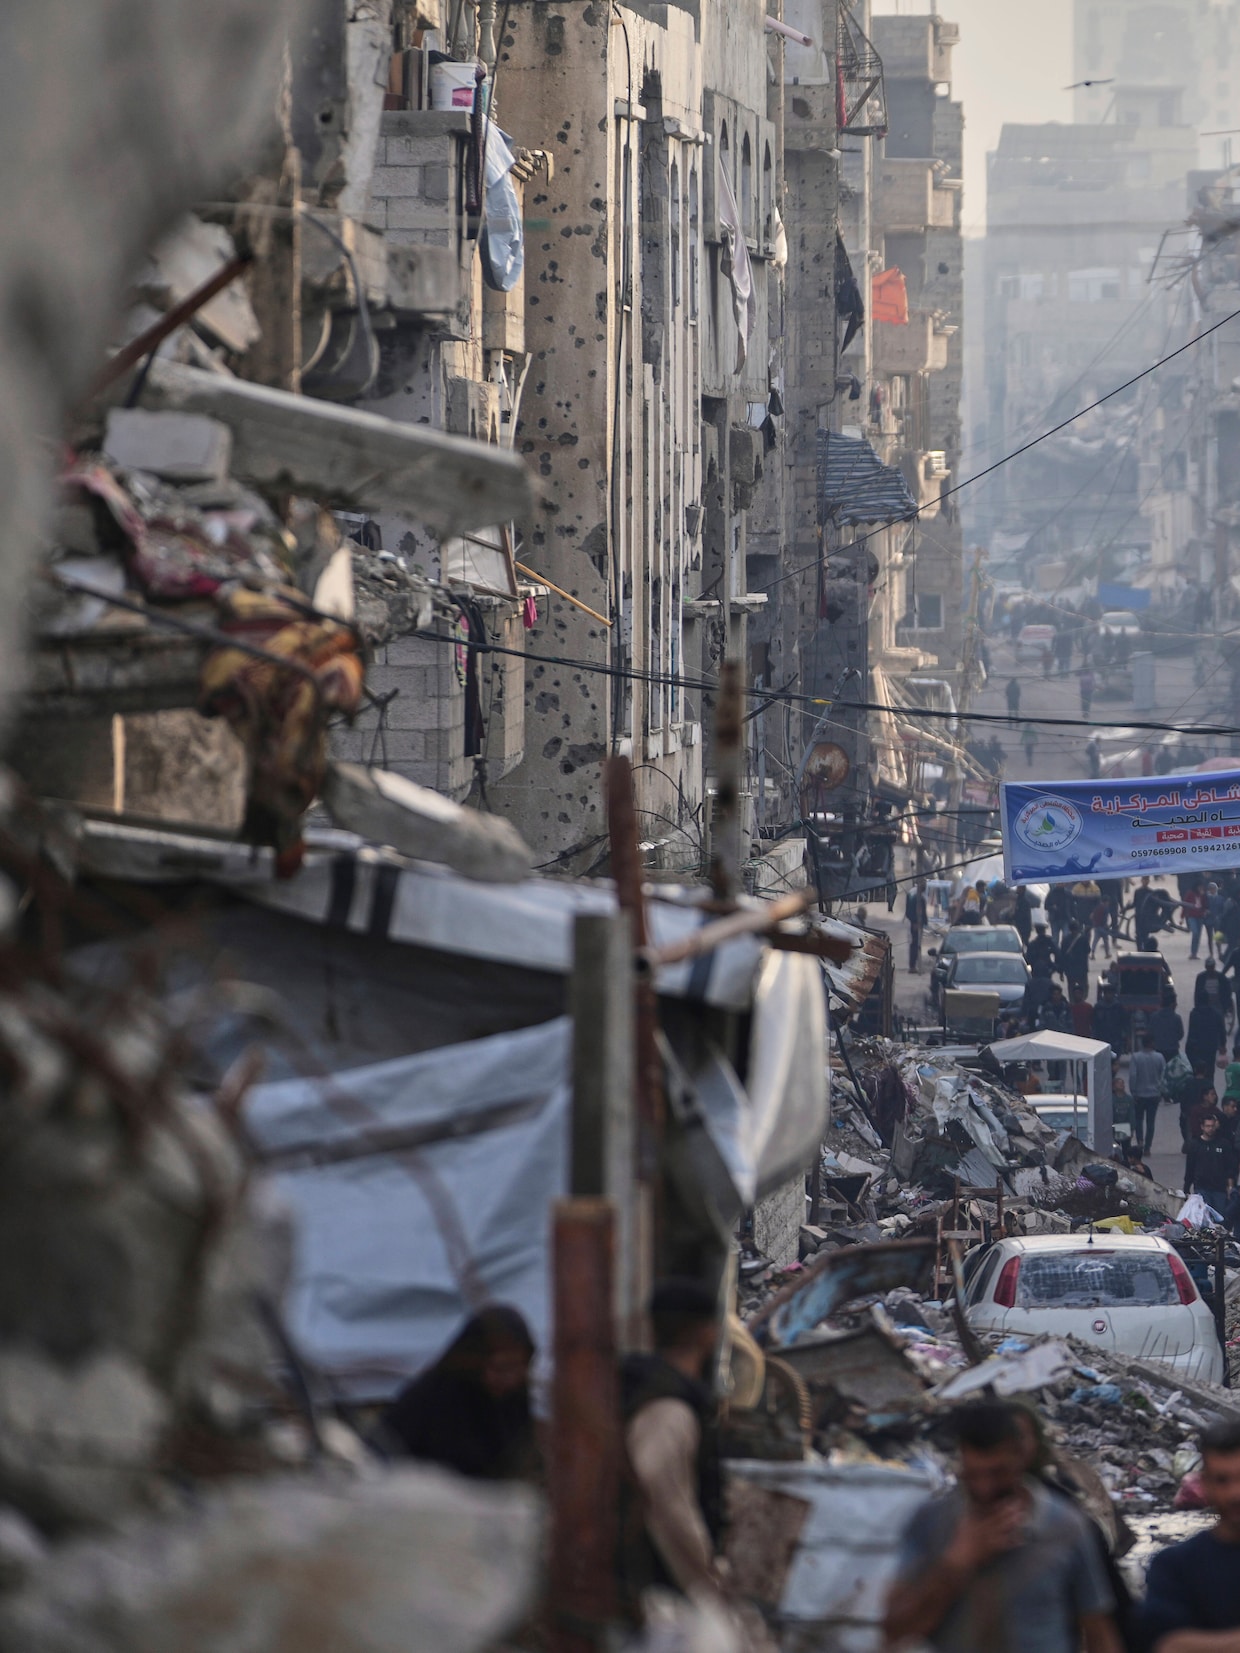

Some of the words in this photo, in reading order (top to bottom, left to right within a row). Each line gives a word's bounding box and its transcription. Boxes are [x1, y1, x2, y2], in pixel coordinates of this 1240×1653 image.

[1091, 791, 1180, 815] المركزية
[1131, 811, 1207, 829] الصحية
[1161, 831, 1184, 841] صحية
[1196, 827, 1212, 839] نقية
[1131, 846, 1187, 858] 0597669908
